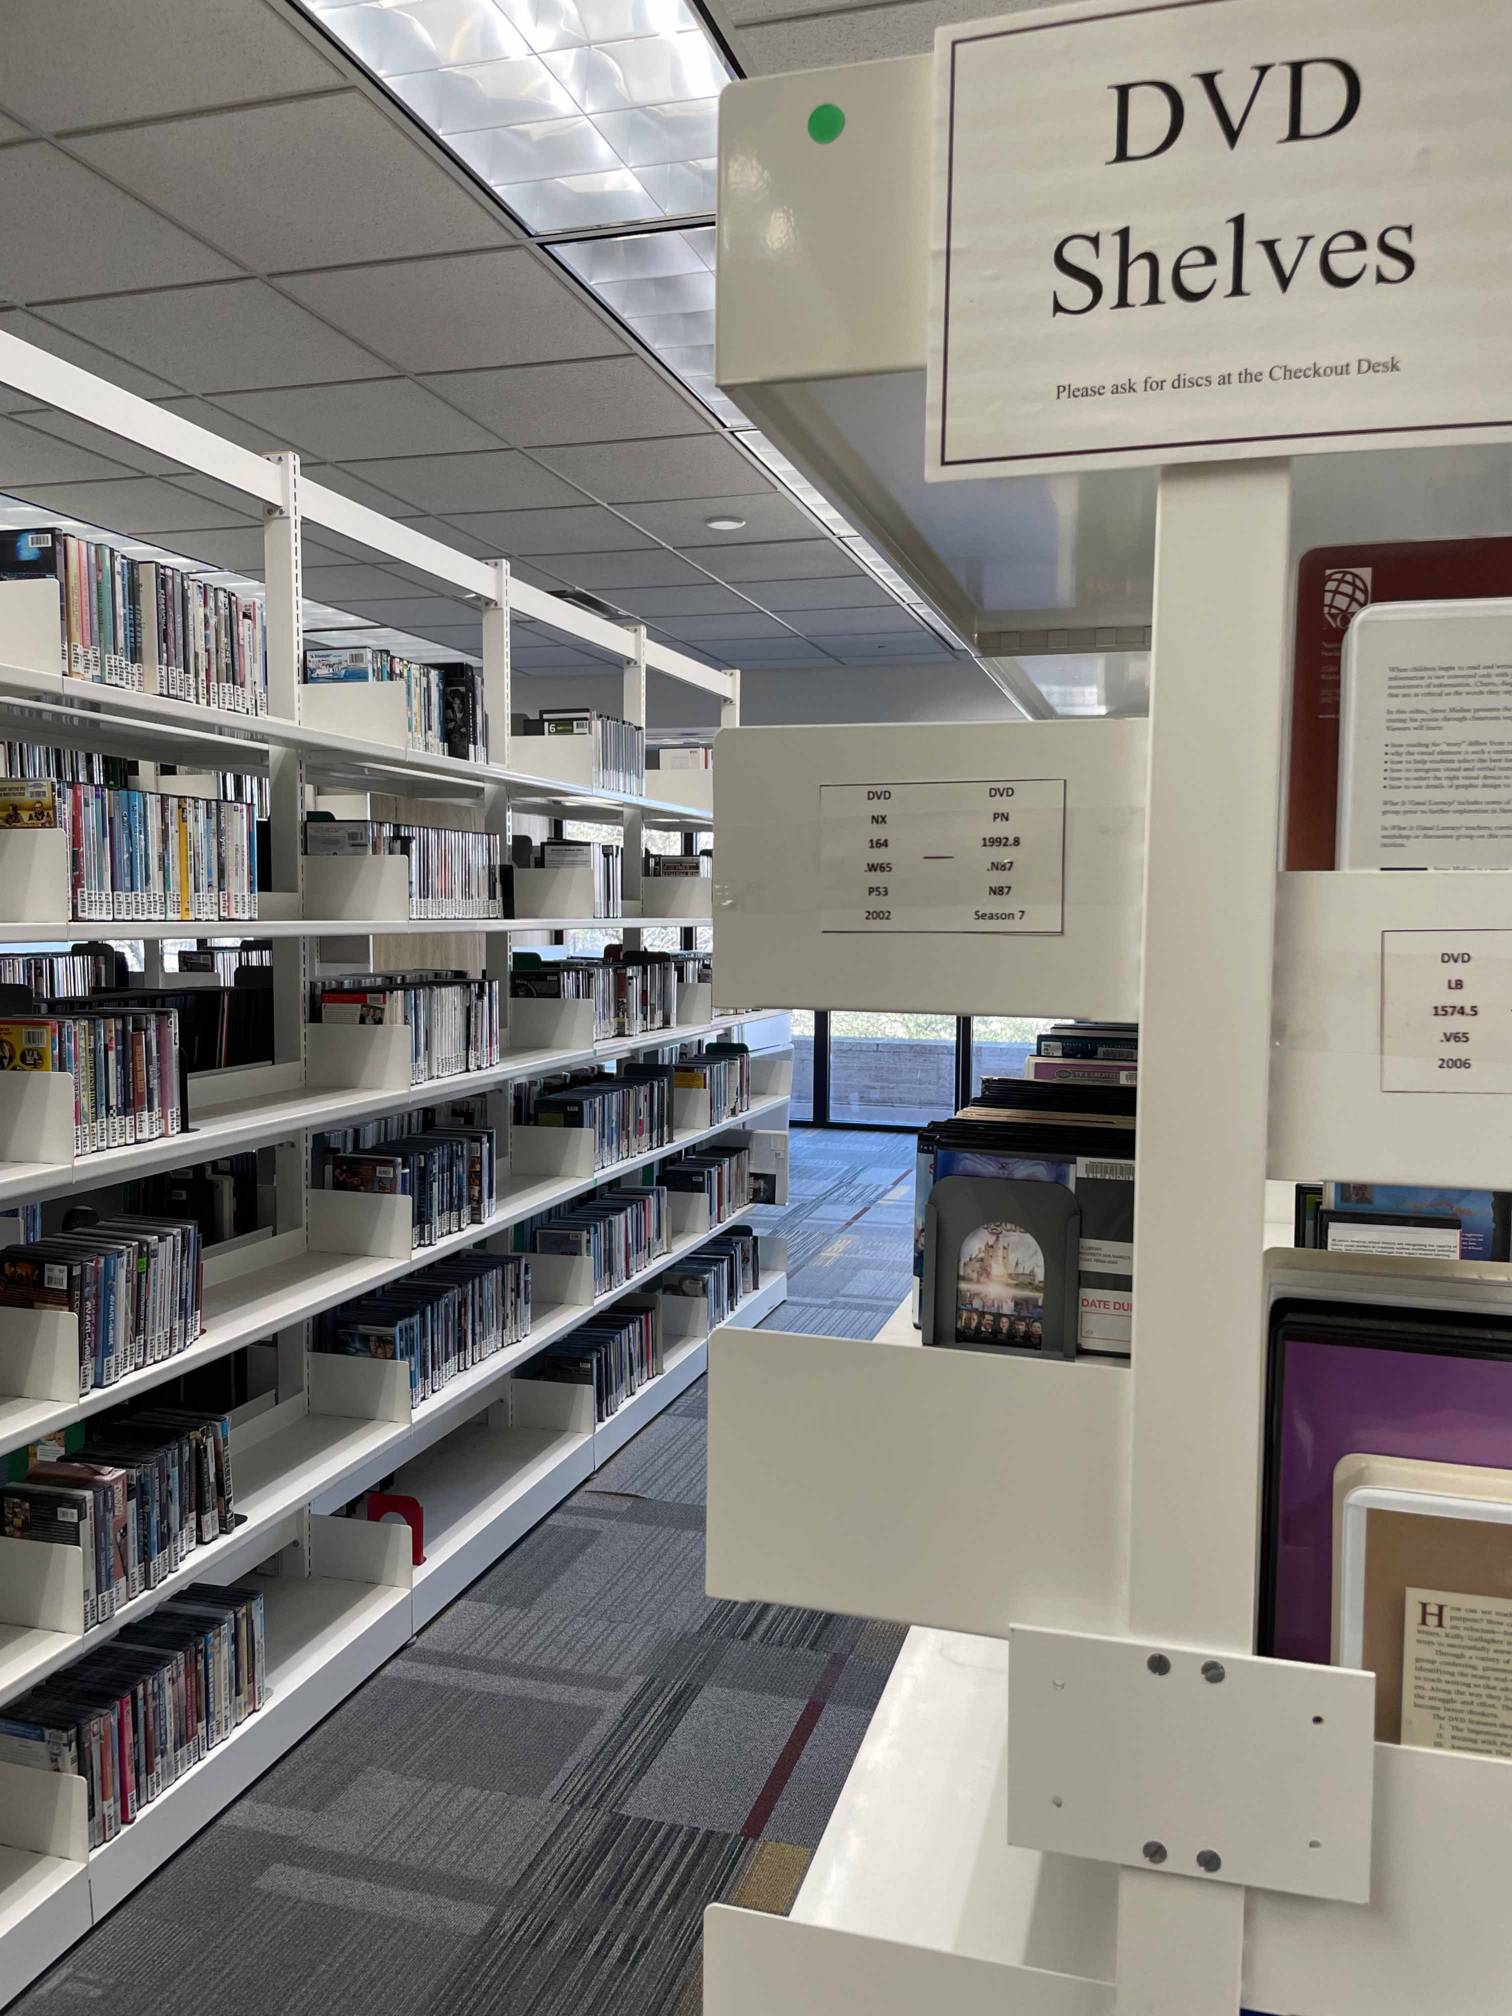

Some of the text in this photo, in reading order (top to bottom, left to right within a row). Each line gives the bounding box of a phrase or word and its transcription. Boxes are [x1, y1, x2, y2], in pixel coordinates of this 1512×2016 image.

[1105, 57, 1361, 165] DVD
[1052, 213, 1416, 318] Shelves
[1056, 356, 1401, 399] Please ask for discs at the Checkout Desk
[867, 790, 892, 801] DVD
[989, 786, 1015, 798] DVD
[871, 814, 888, 825] NX
[993, 811, 1010, 823] PN
[869, 838, 889, 849] 164
[982, 836, 1021, 847] 1992.8
[865, 862, 893, 873] .W65
[868, 886, 889, 897] P53
[989, 885, 1012, 897] N87
[865, 910, 892, 921] 2002
[974, 910, 1026, 921] Season 7
[1441, 953, 1471, 964] DVD
[1448, 979, 1464, 990] LB
[1432, 1005, 1478, 1017] 1574.5
[1440, 1032, 1470, 1043] .V65
[1438, 1058, 1472, 1069] 2006
[1081, 1298, 1132, 1312] DATE DU
